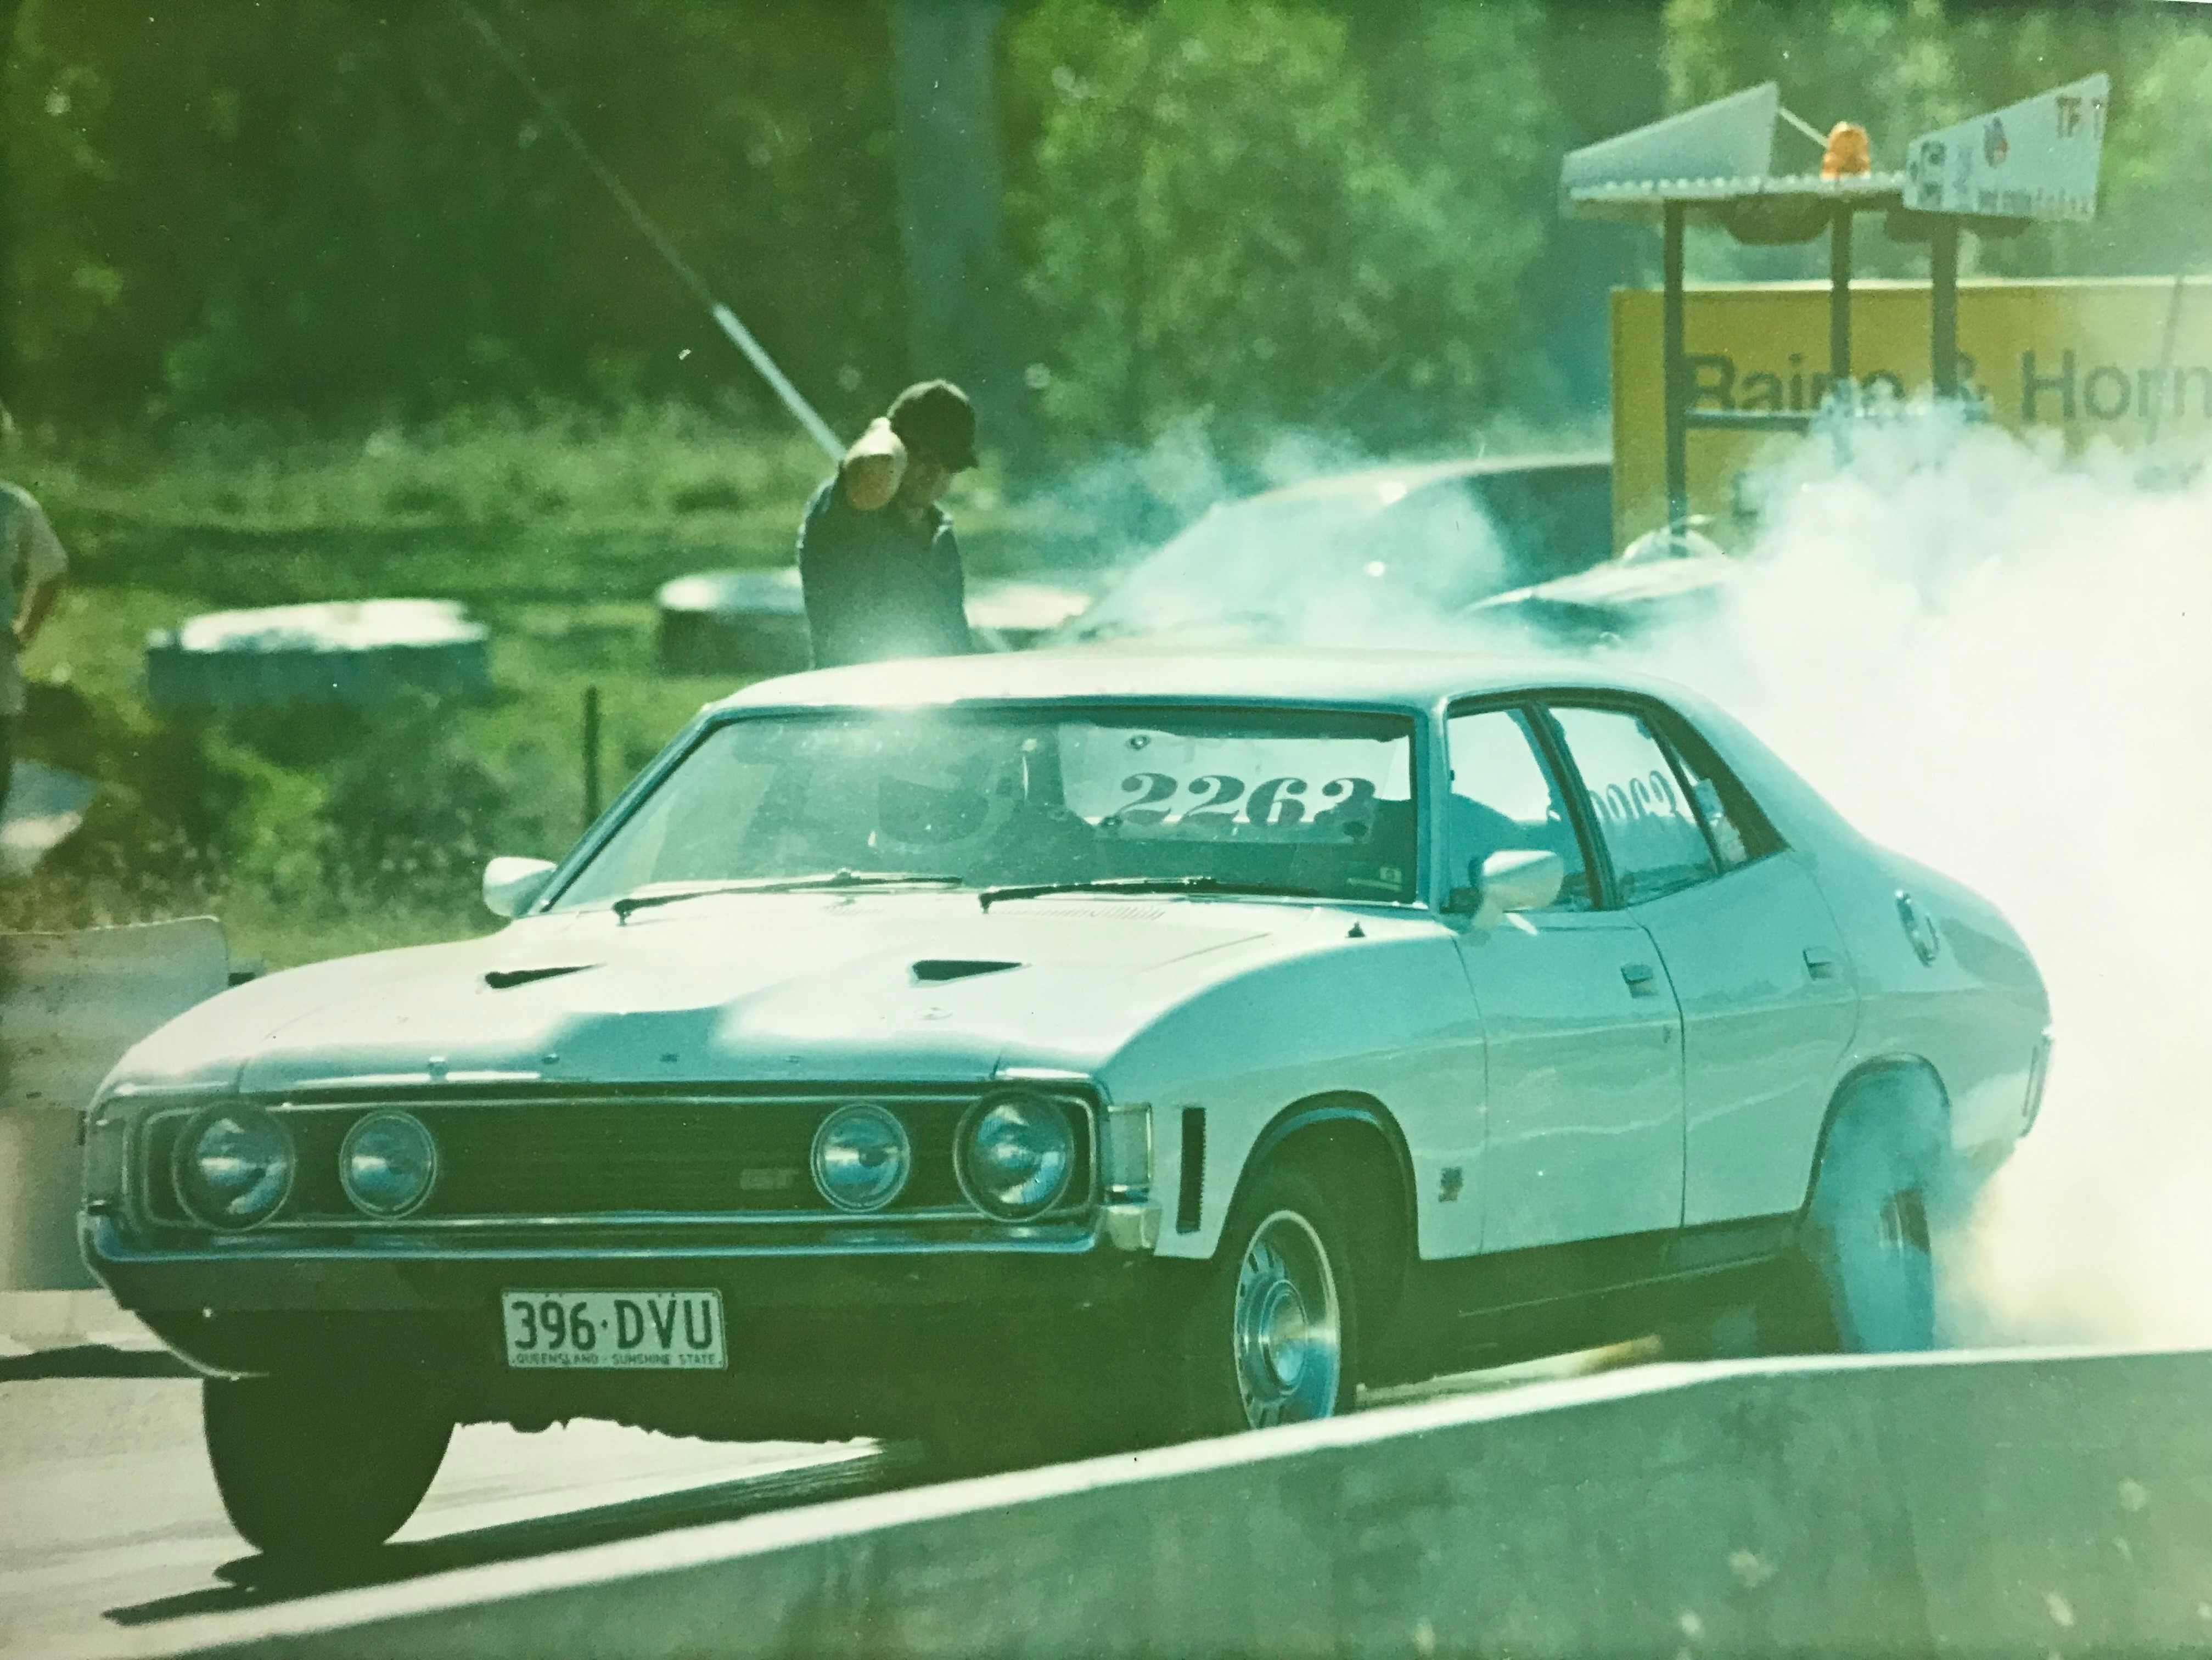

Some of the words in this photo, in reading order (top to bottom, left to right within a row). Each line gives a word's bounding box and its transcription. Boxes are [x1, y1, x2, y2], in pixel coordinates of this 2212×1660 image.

[2021, 349, 2212, 421] Horn
[515, 1353, 599, 1365] QUEENSLAND
[611, 1353, 670, 1365] SUNSHINE
[678, 1353, 715, 1365] STATE
